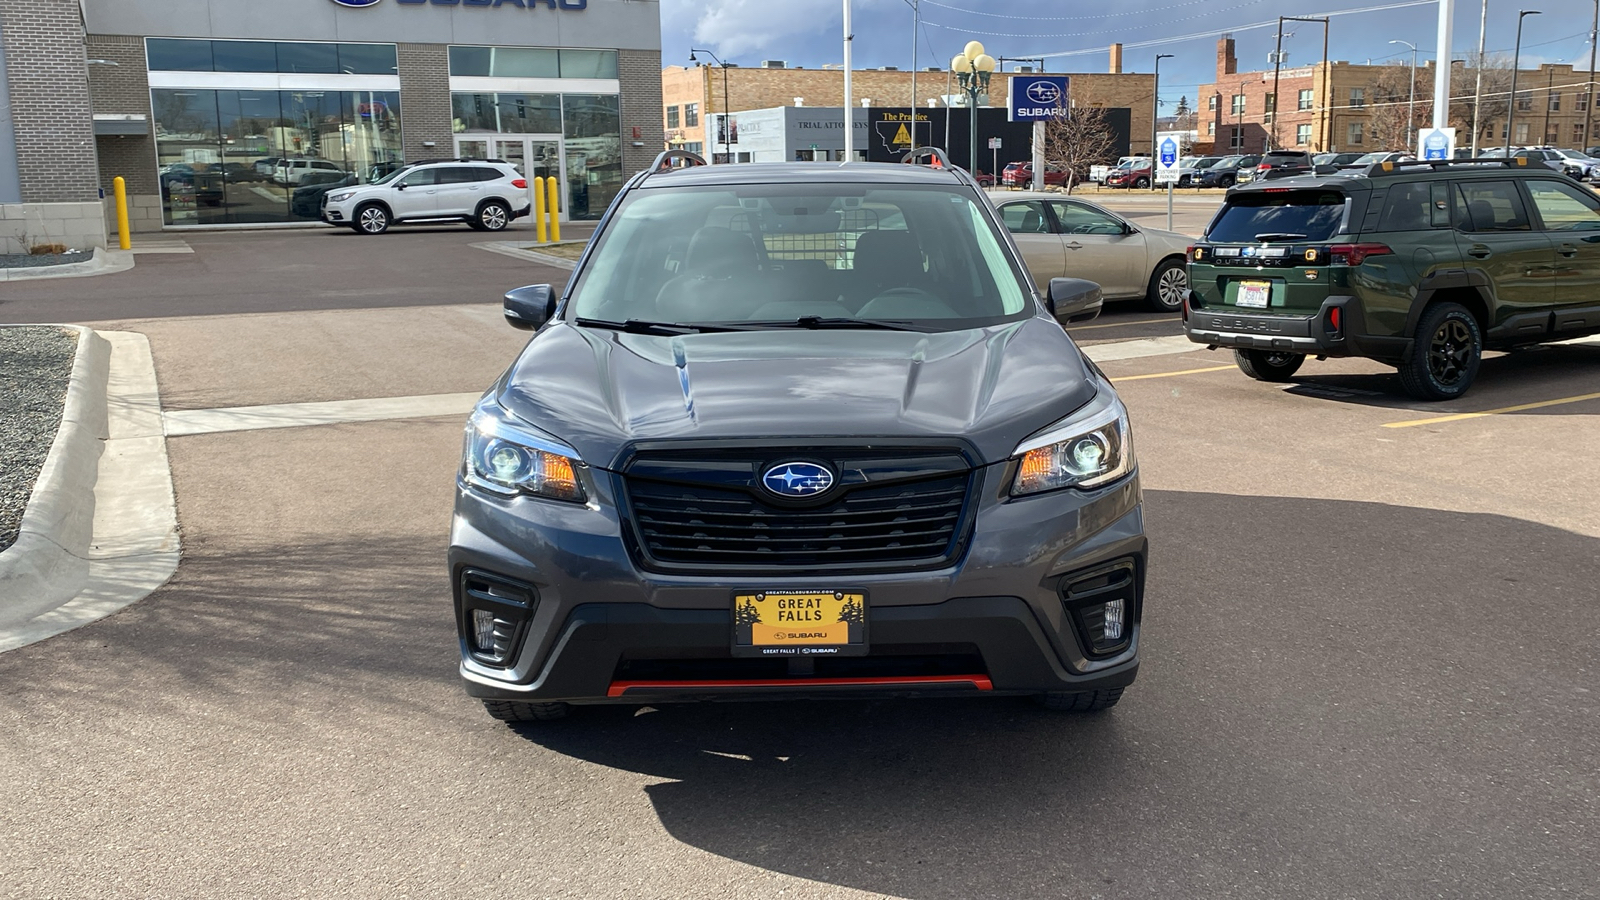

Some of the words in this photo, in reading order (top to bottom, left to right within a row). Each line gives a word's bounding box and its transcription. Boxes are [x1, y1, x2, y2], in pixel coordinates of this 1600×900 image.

[882, 112, 898, 121] The
[899, 112, 928, 121] Pratice
[1017, 108, 1066, 116] SUBARU
[798, 121, 822, 129] TRIAL
[824, 121, 869, 129] ATTOEYS
[1211, 318, 1282, 331] SUBARU
[778, 598, 822, 609] GREAT
[778, 610, 822, 621] FALLS
